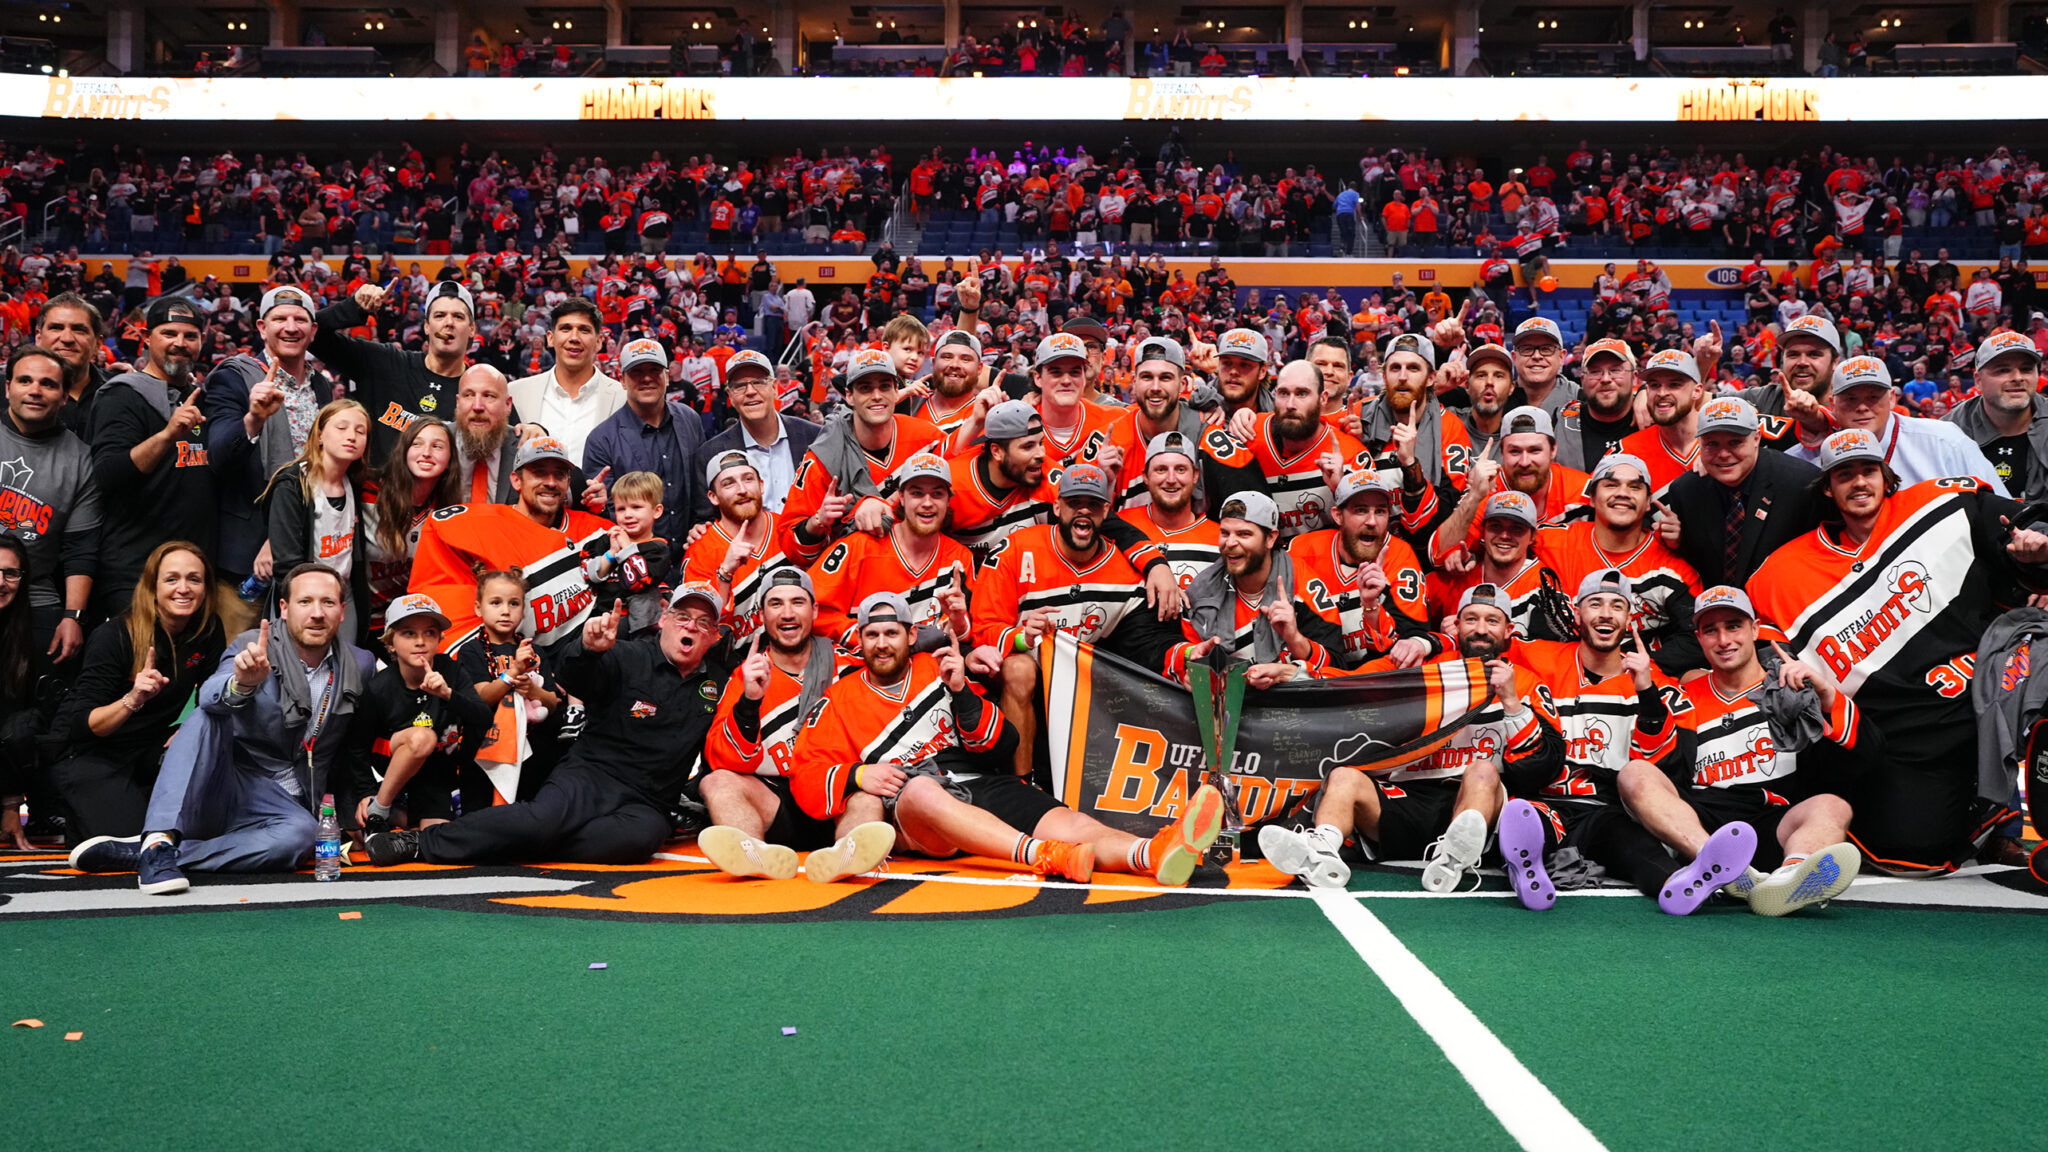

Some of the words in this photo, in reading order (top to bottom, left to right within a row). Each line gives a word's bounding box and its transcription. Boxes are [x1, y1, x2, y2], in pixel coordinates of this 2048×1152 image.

[578, 88, 717, 120] CHAMPIONS
[1677, 88, 1820, 121] CHAMPIONS
[1717, 270, 1737, 283] 106
[1842, 359, 1880, 375] BUFFALO
[1704, 401, 1740, 416] BUFFALO
[1830, 431, 1871, 450] BUFFALO
[821, 541, 849, 574] 8
[1019, 551, 1037, 584] A
[1815, 570, 1925, 685] BANDITS
